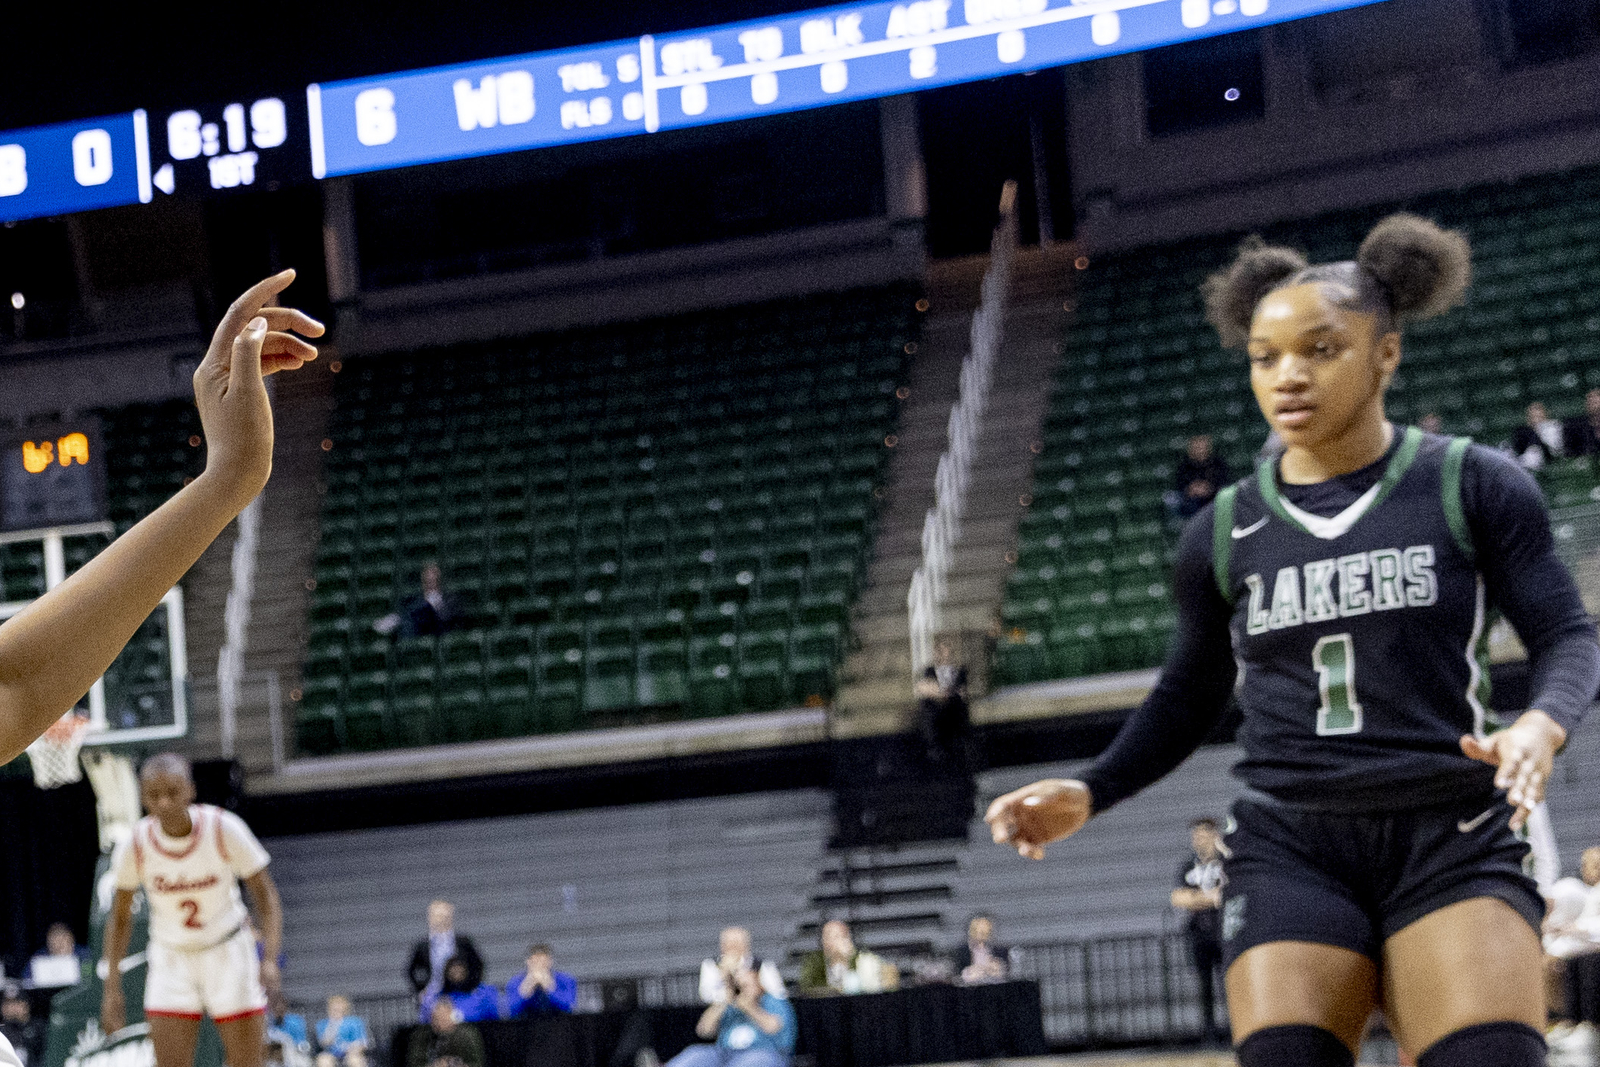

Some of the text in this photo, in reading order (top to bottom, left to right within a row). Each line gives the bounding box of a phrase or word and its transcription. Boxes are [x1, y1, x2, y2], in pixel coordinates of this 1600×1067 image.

[168, 97, 287, 160] 6:19
[355, 70, 536, 146] 6 WB
[72, 128, 113, 186] 0
[1244, 545, 1437, 634] LAKERS
[1312, 633, 1362, 736] 1
[179, 900, 203, 930] 2
